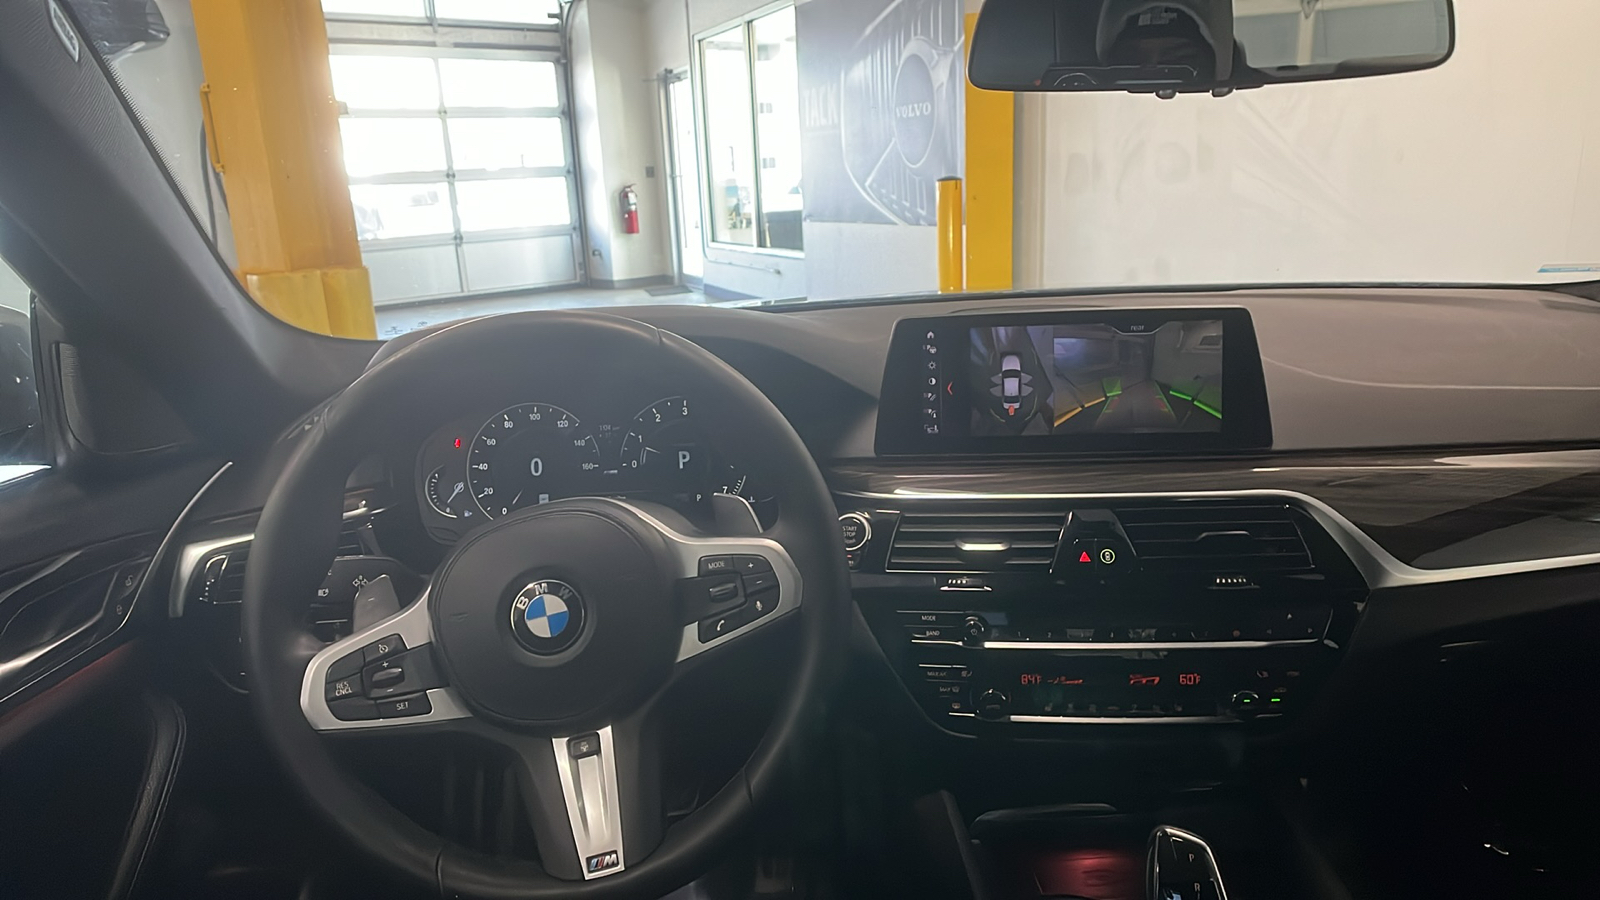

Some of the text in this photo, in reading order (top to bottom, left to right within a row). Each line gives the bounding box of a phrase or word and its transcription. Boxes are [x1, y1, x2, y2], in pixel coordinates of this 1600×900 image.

[895, 102, 931, 118] VOLVO
[682, 407, 688, 415] 3
[655, 414, 661, 422] 2
[557, 420, 568, 428] 120
[631, 460, 637, 468] 0
[678, 451, 690, 469] P
[530, 457, 543, 476] 0
[722, 486, 728, 494] 7
[708, 561, 725, 569] MODE
[516, 583, 573, 610] BMW
[335, 687, 352, 696] CNCL
[396, 702, 409, 710] SET
[1188, 853, 1195, 862] P
[1194, 882, 1200, 892] R
